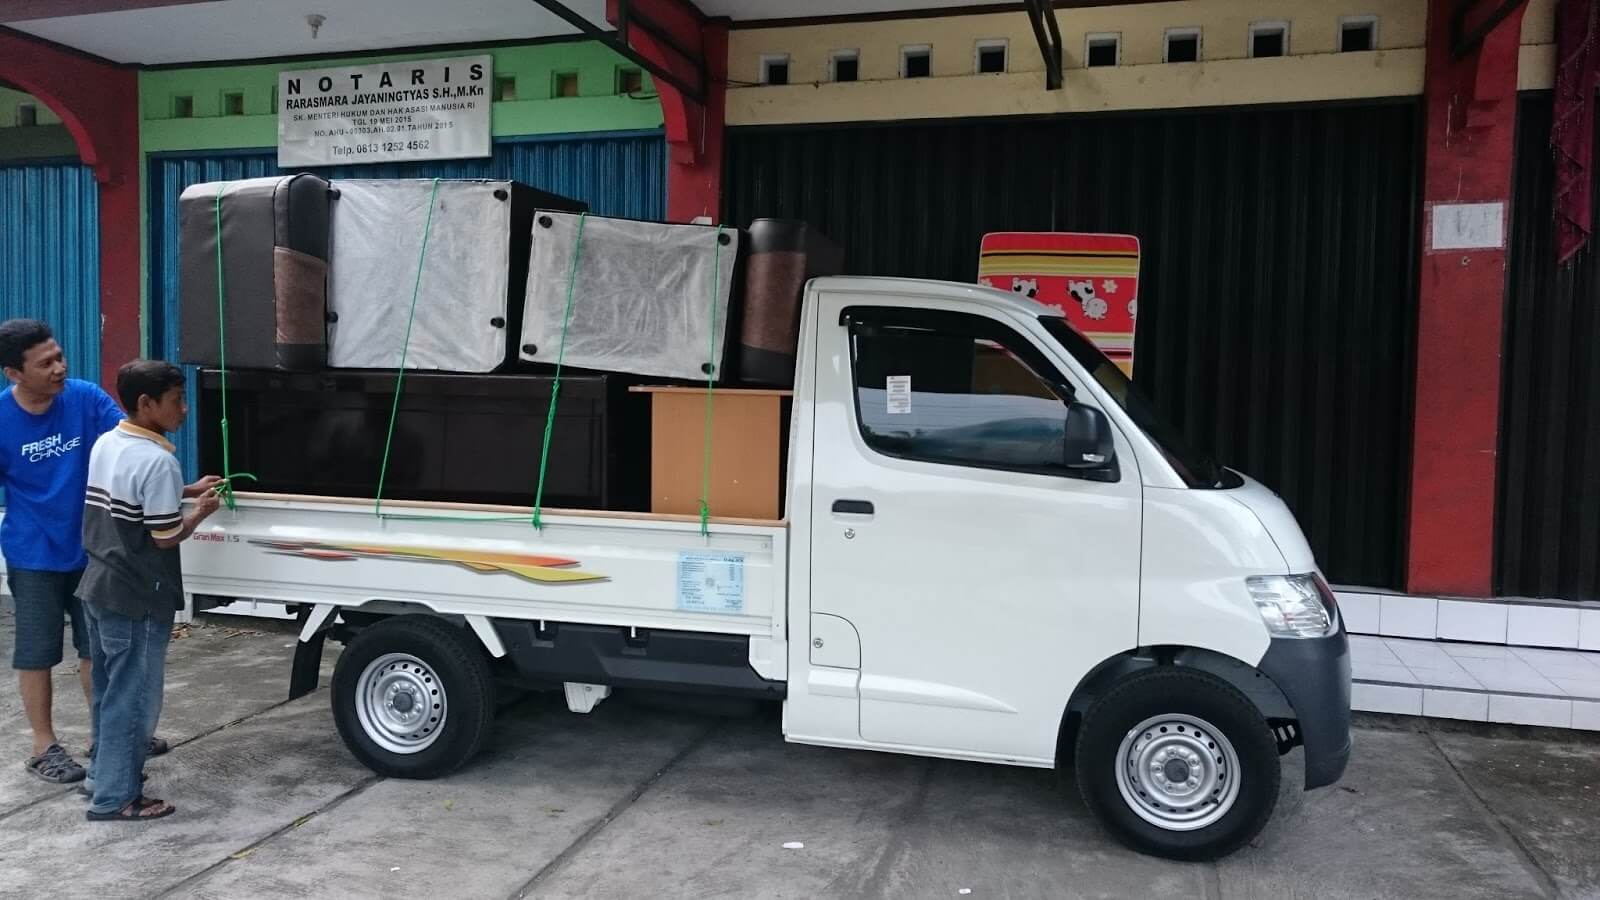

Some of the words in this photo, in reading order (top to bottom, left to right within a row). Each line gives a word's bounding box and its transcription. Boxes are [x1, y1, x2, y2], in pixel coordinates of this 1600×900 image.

[288, 64, 483, 95] NOTARIS
[286, 95, 348, 110] RARASMARA
[351, 88, 429, 105] JAYANINGTYAS
[308, 112, 339, 120] MENTERI
[387, 107, 404, 115] HAK
[406, 105, 428, 113] ASASI
[430, 102, 465, 112] MANUSIA
[467, 101, 475, 109] RI
[395, 115, 412, 123] 2015
[333, 145, 354, 156] Telp.
[356, 143, 379, 154] 0813
[382, 141, 404, 152] 1252
[407, 139, 430, 150] 4562
[21, 433, 62, 456] FRESH
[29, 436, 81, 463] CHANGE
